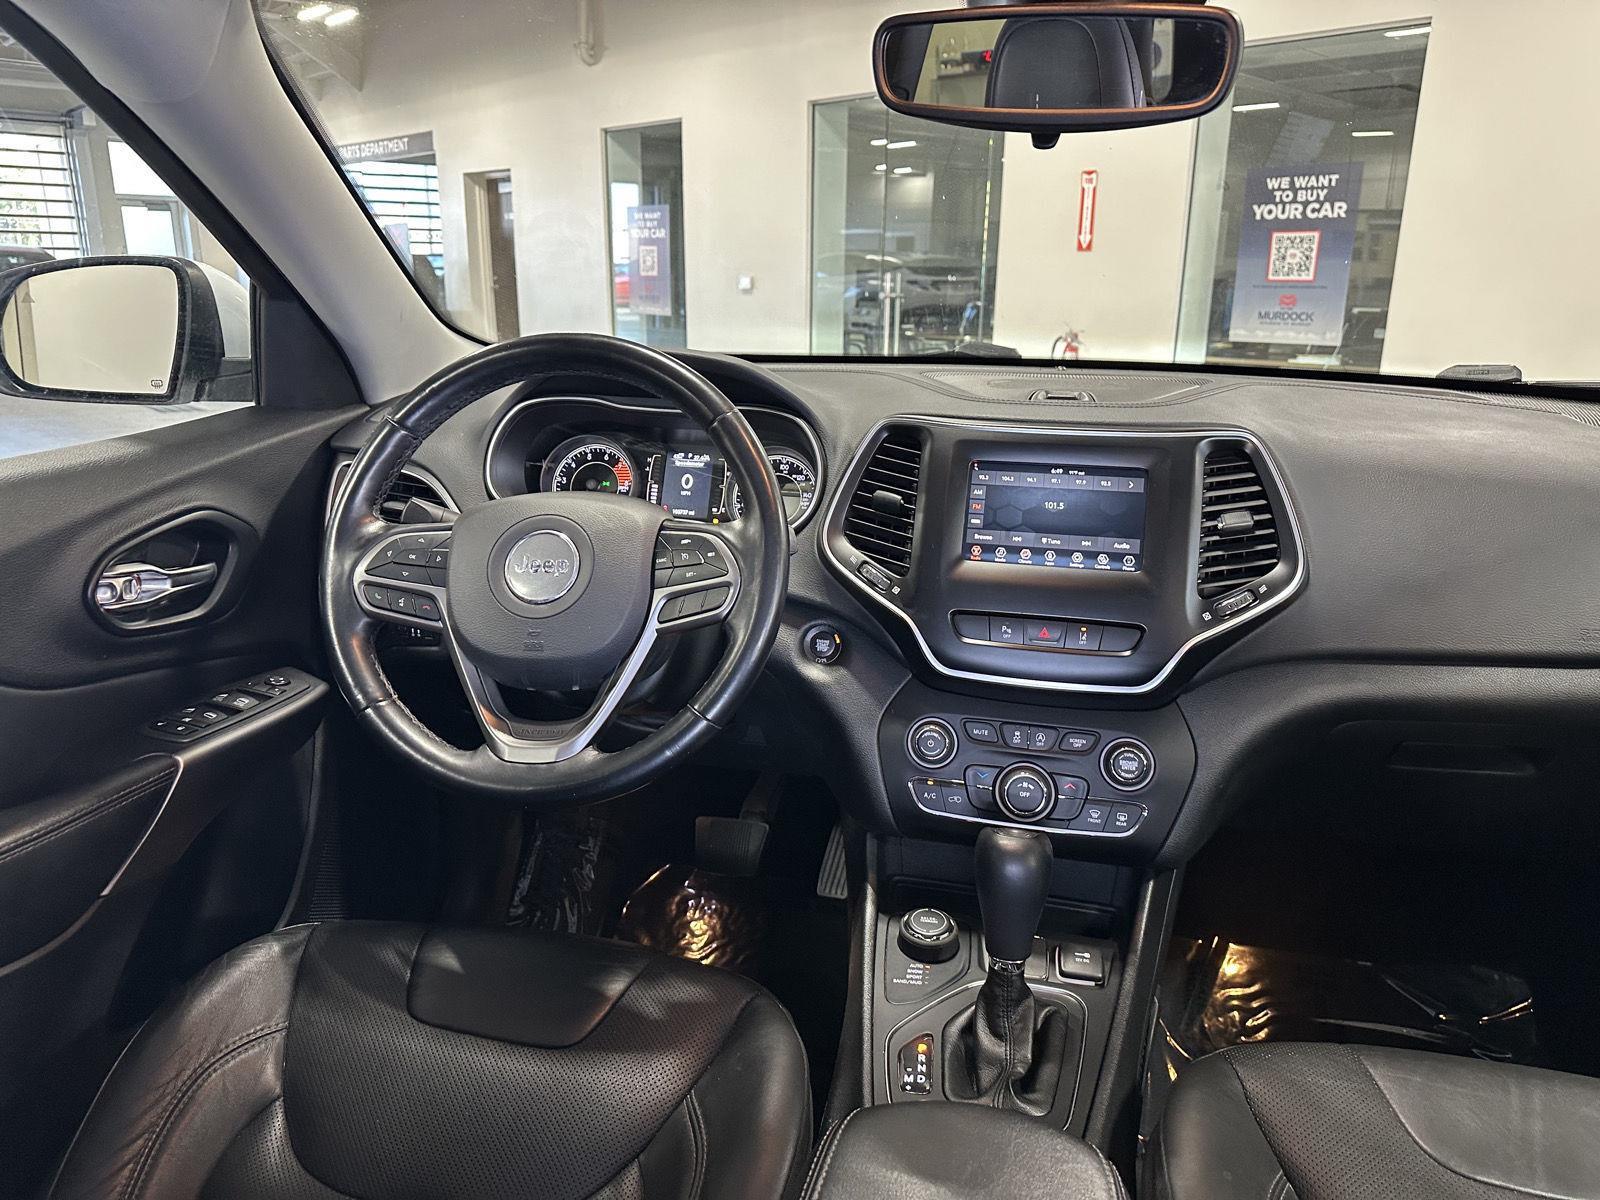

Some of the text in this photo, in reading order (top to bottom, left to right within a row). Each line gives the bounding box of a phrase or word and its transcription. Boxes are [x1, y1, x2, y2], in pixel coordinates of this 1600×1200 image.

[340, 138, 408, 158] PARTS DEPARTMENT
[1266, 174, 1339, 190] WE WANT
[1274, 188, 1328, 202] TO BUY
[1252, 201, 1348, 220] YOUR CAR
[651, 228, 666, 238] CAR
[1258, 311, 1314, 322] MURDOCK
[681, 473, 694, 489] 0
[1044, 501, 1065, 510] 101.5
[1113, 542, 1130, 550] Audio
[513, 553, 570, 577] Jeep
[973, 728, 988, 736] MUTE
[917, 1054, 926, 1062] R
[917, 1064, 927, 1073] N
[903, 1074, 914, 1083] M
[917, 1074, 926, 1083] D
